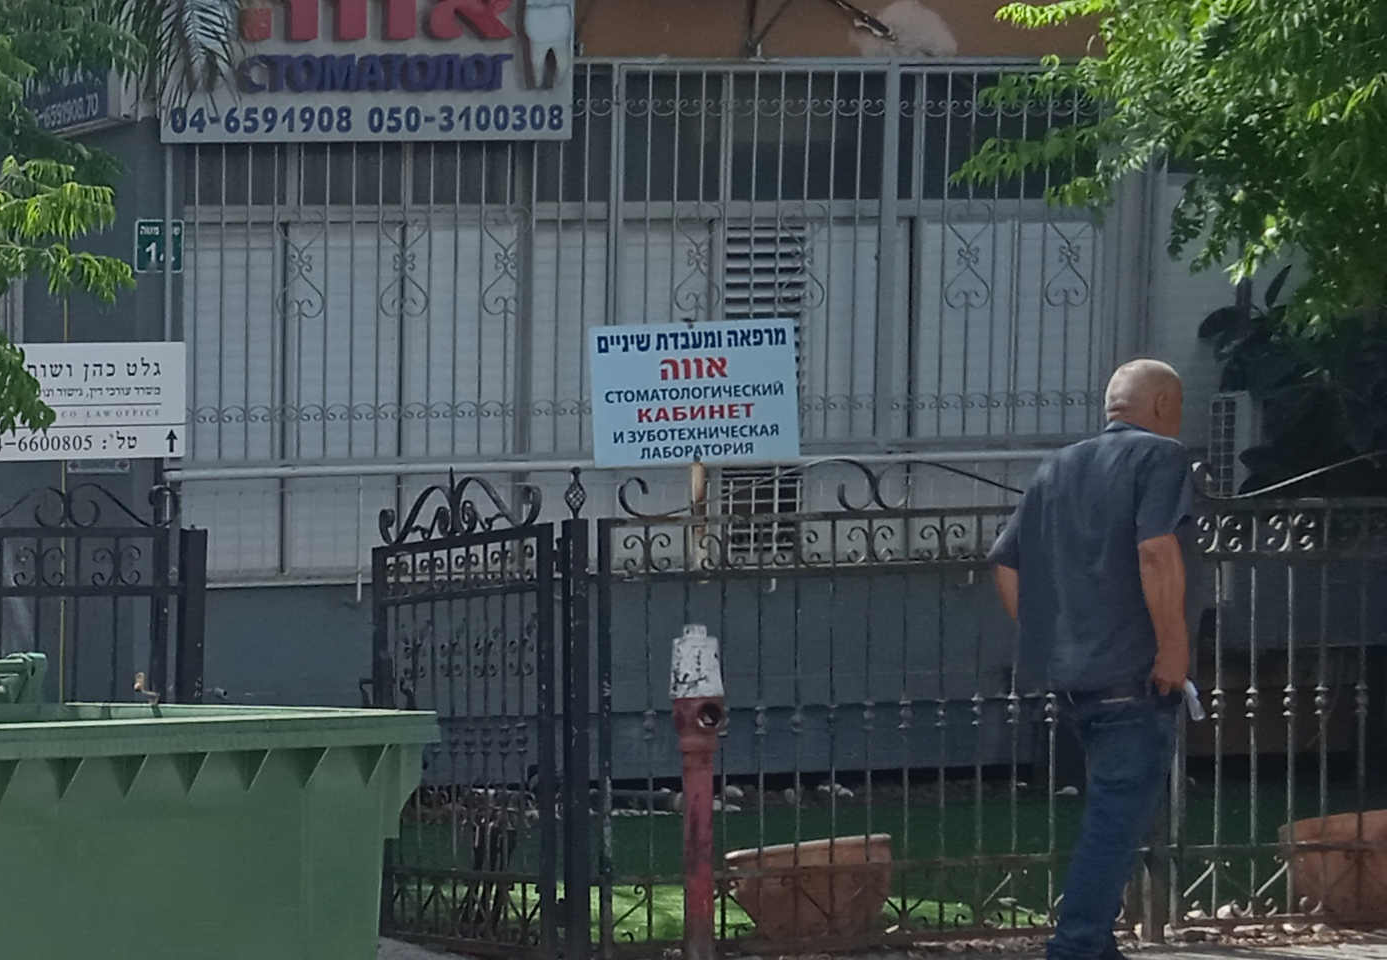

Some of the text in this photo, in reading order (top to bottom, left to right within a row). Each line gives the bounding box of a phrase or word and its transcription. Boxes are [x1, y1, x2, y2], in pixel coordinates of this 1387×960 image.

[237, 53, 514, 93] СТОМАТОЛОГ
[171, 104, 564, 134] 04-6591908 050-3100308
[597, 327, 787, 353] מרפאה ומעבדת שיניים
[84, 362, 116, 382] כהן
[127, 357, 162, 377] גלט
[659, 357, 728, 381] אווה
[605, 381, 785, 404] СТОМАТОЛОГИЧЕСКИЙ
[637, 403, 755, 423] КАБИНЕТ
[613, 424, 780, 444] И ЗУБОТЕХНИЧЕСКАЯ
[640, 442, 754, 460] ЛАБОРАТОРИЯ
